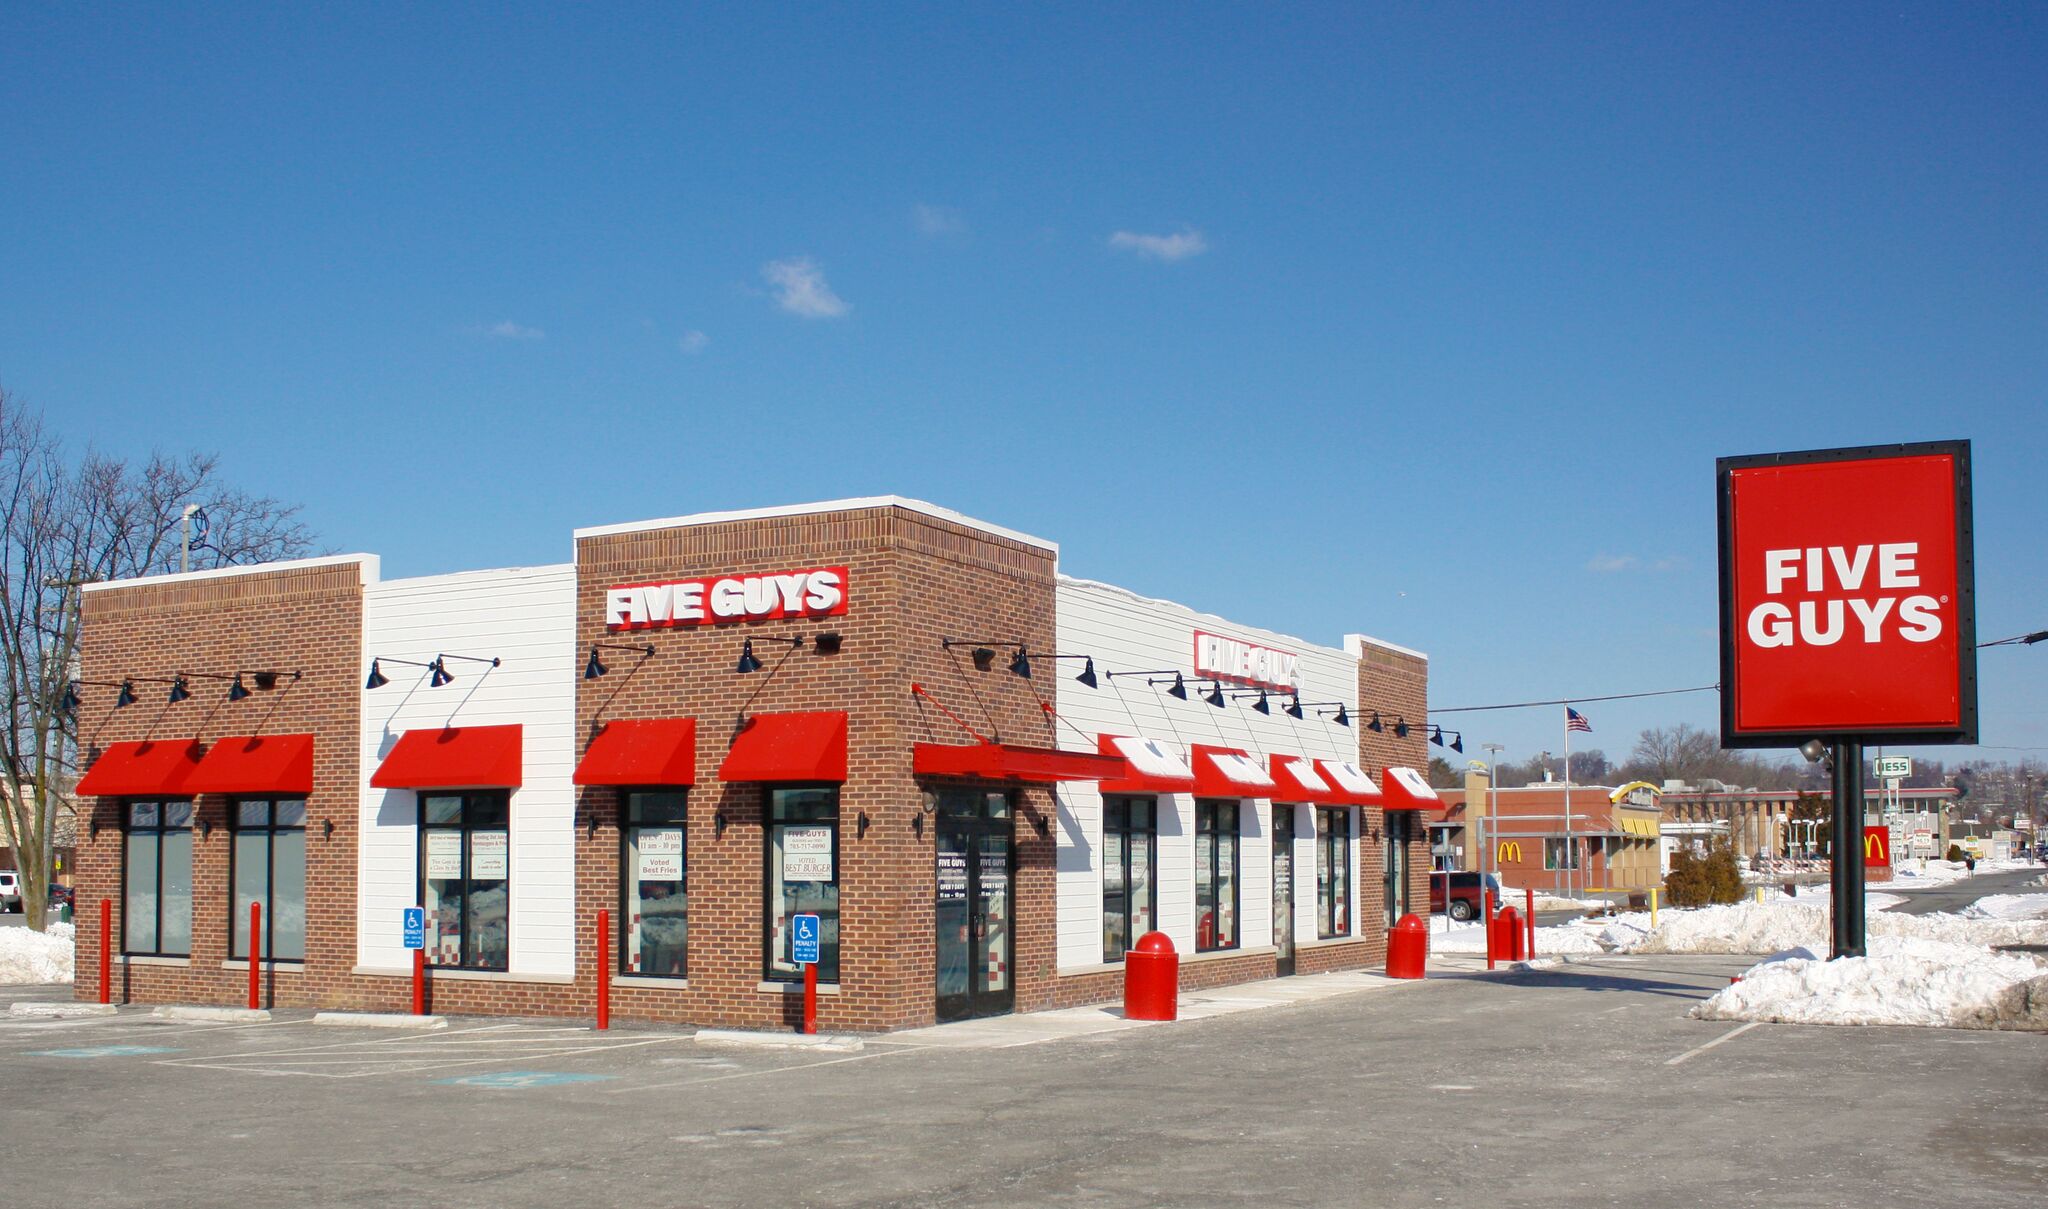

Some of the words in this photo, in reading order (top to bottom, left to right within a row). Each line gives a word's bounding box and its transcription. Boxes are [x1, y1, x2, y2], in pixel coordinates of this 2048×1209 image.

[1765, 542, 1920, 594] FIVE
[606, 582, 705, 625] FIVE
[711, 570, 842, 617] GUYS
[1747, 595, 1943, 648] GUYS
[664, 833, 681, 841] DAYS
[670, 843, 680, 851] pm
[938, 858, 951, 867] FIVE
[951, 858, 966, 867] GUYS
[785, 863, 801, 872] BEST
[803, 863, 831, 873] BURGER
